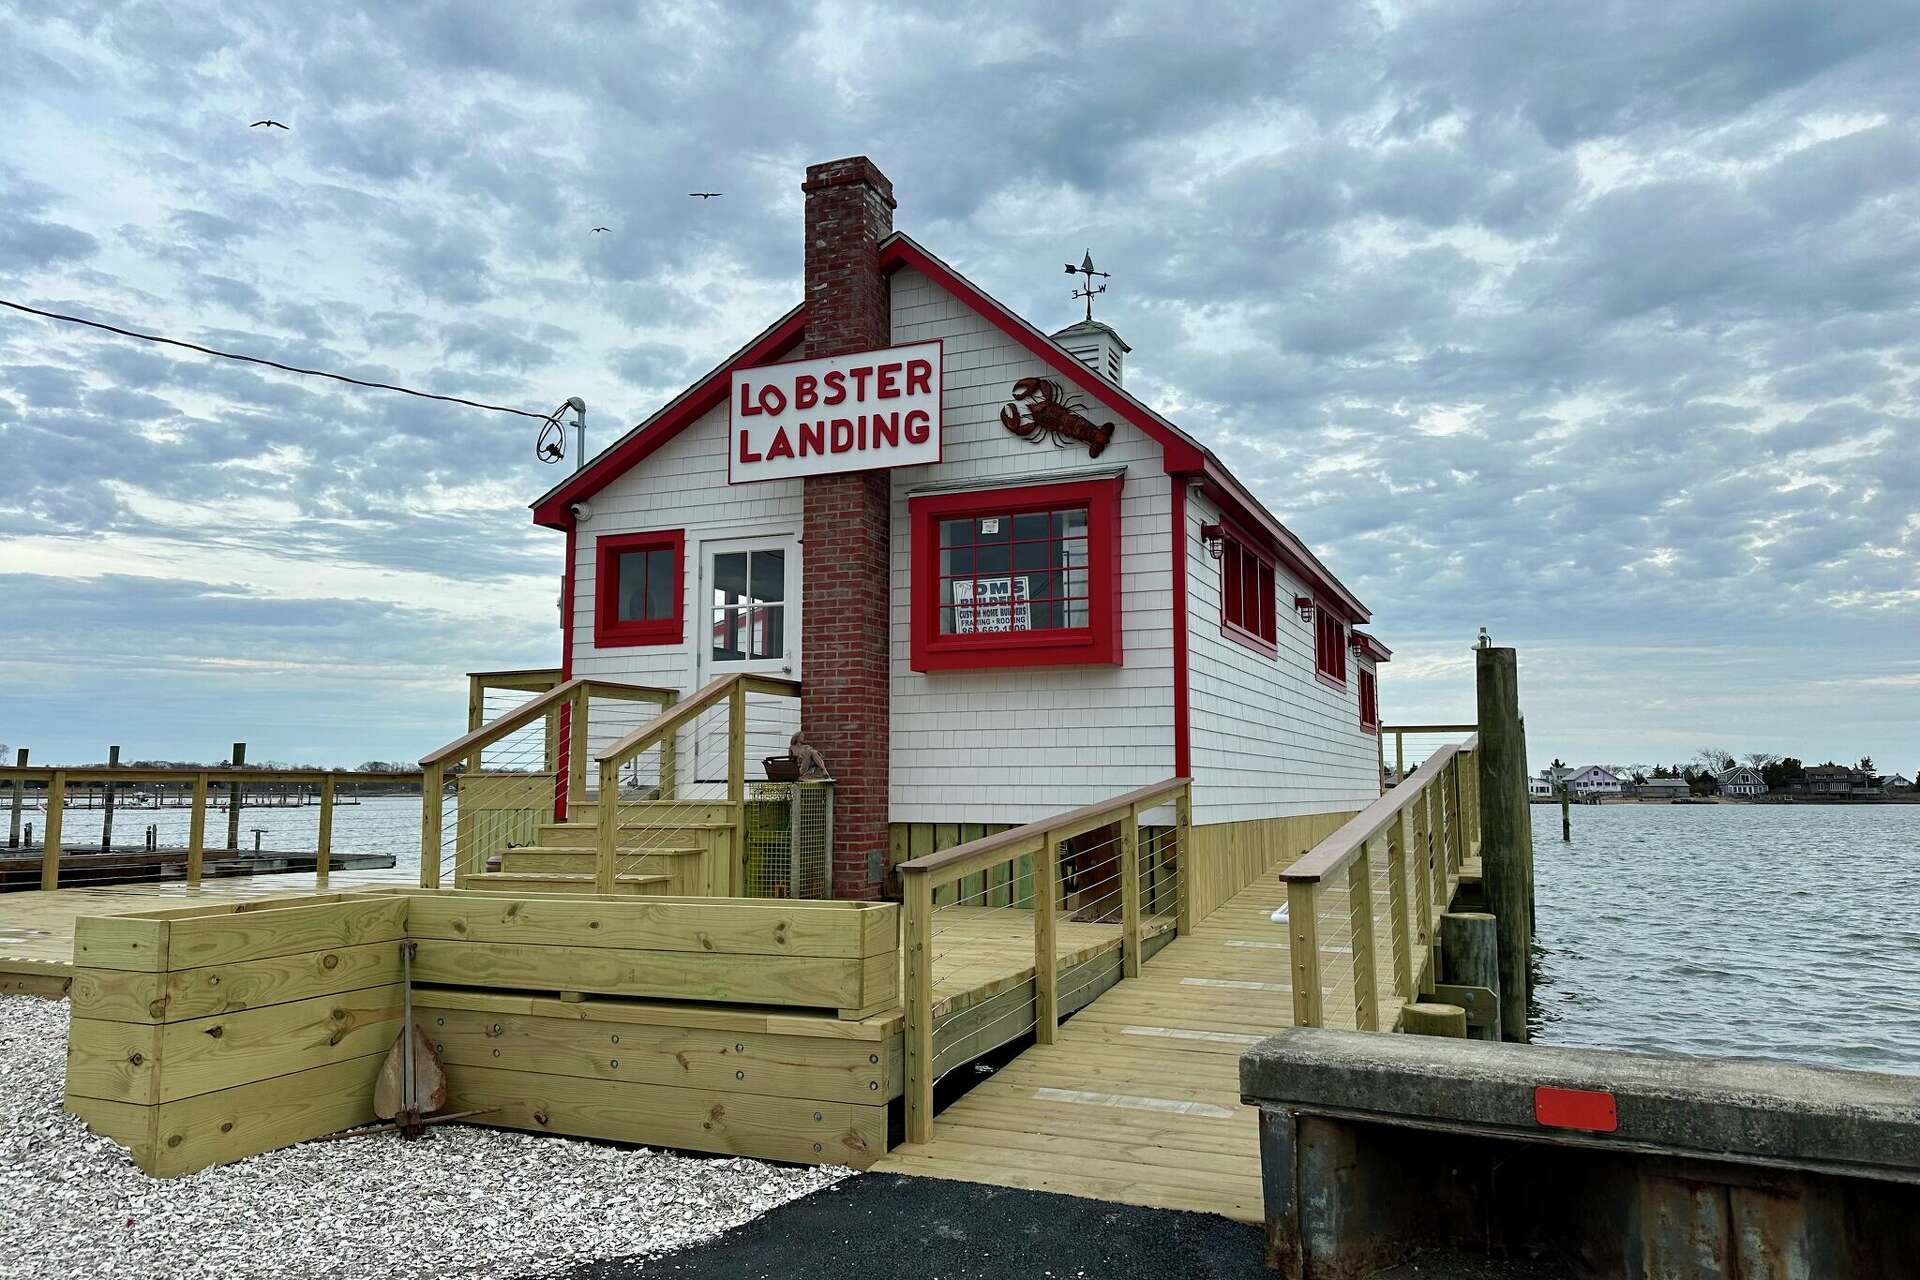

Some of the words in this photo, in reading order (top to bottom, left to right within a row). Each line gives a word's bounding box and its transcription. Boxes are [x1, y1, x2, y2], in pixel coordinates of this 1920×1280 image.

[741, 359, 932, 416] LOBSTER
[739, 409, 930, 463] LANDING
[975, 581, 1025, 596] DMS
[960, 609, 981, 619] CUSTM
[983, 608, 999, 618] HOME
[1000, 607, 1026, 616] BUIERS
[961, 619, 990, 627] FRAING
[996, 616, 1025, 625] ROOING
